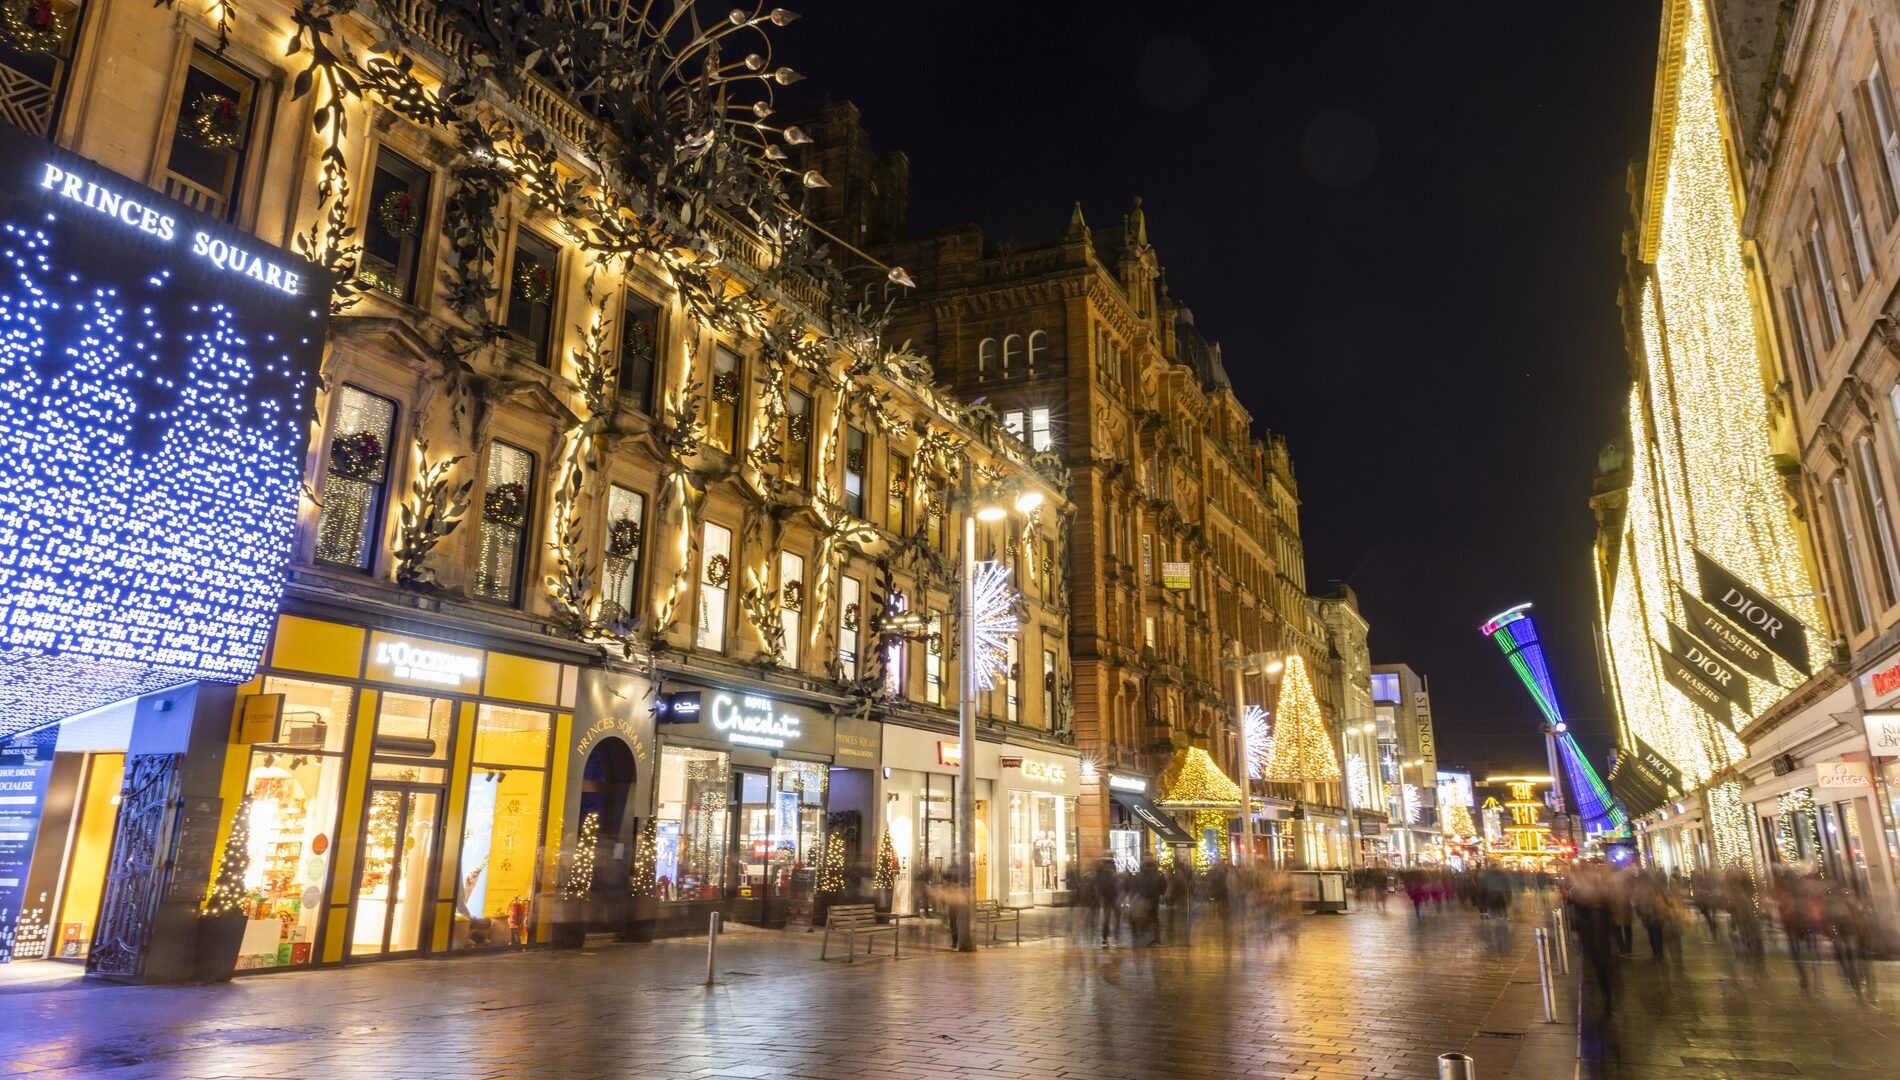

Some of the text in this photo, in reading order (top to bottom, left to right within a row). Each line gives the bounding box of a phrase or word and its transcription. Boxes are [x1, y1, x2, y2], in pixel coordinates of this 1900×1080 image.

[41, 163, 299, 295] PRINCES SQUARE
[1720, 587, 1783, 639] DIOR
[1705, 617, 1760, 660] FRASERS
[1677, 668, 1720, 703] FRASERS
[1685, 646, 1731, 687] DIOR
[577, 716, 646, 762] PRINCES SQUARE
[1416, 697, 1433, 763] ST ENOCH
[1645, 753, 1673, 778] DIOR
[1822, 776, 1870, 786] OMEGA
